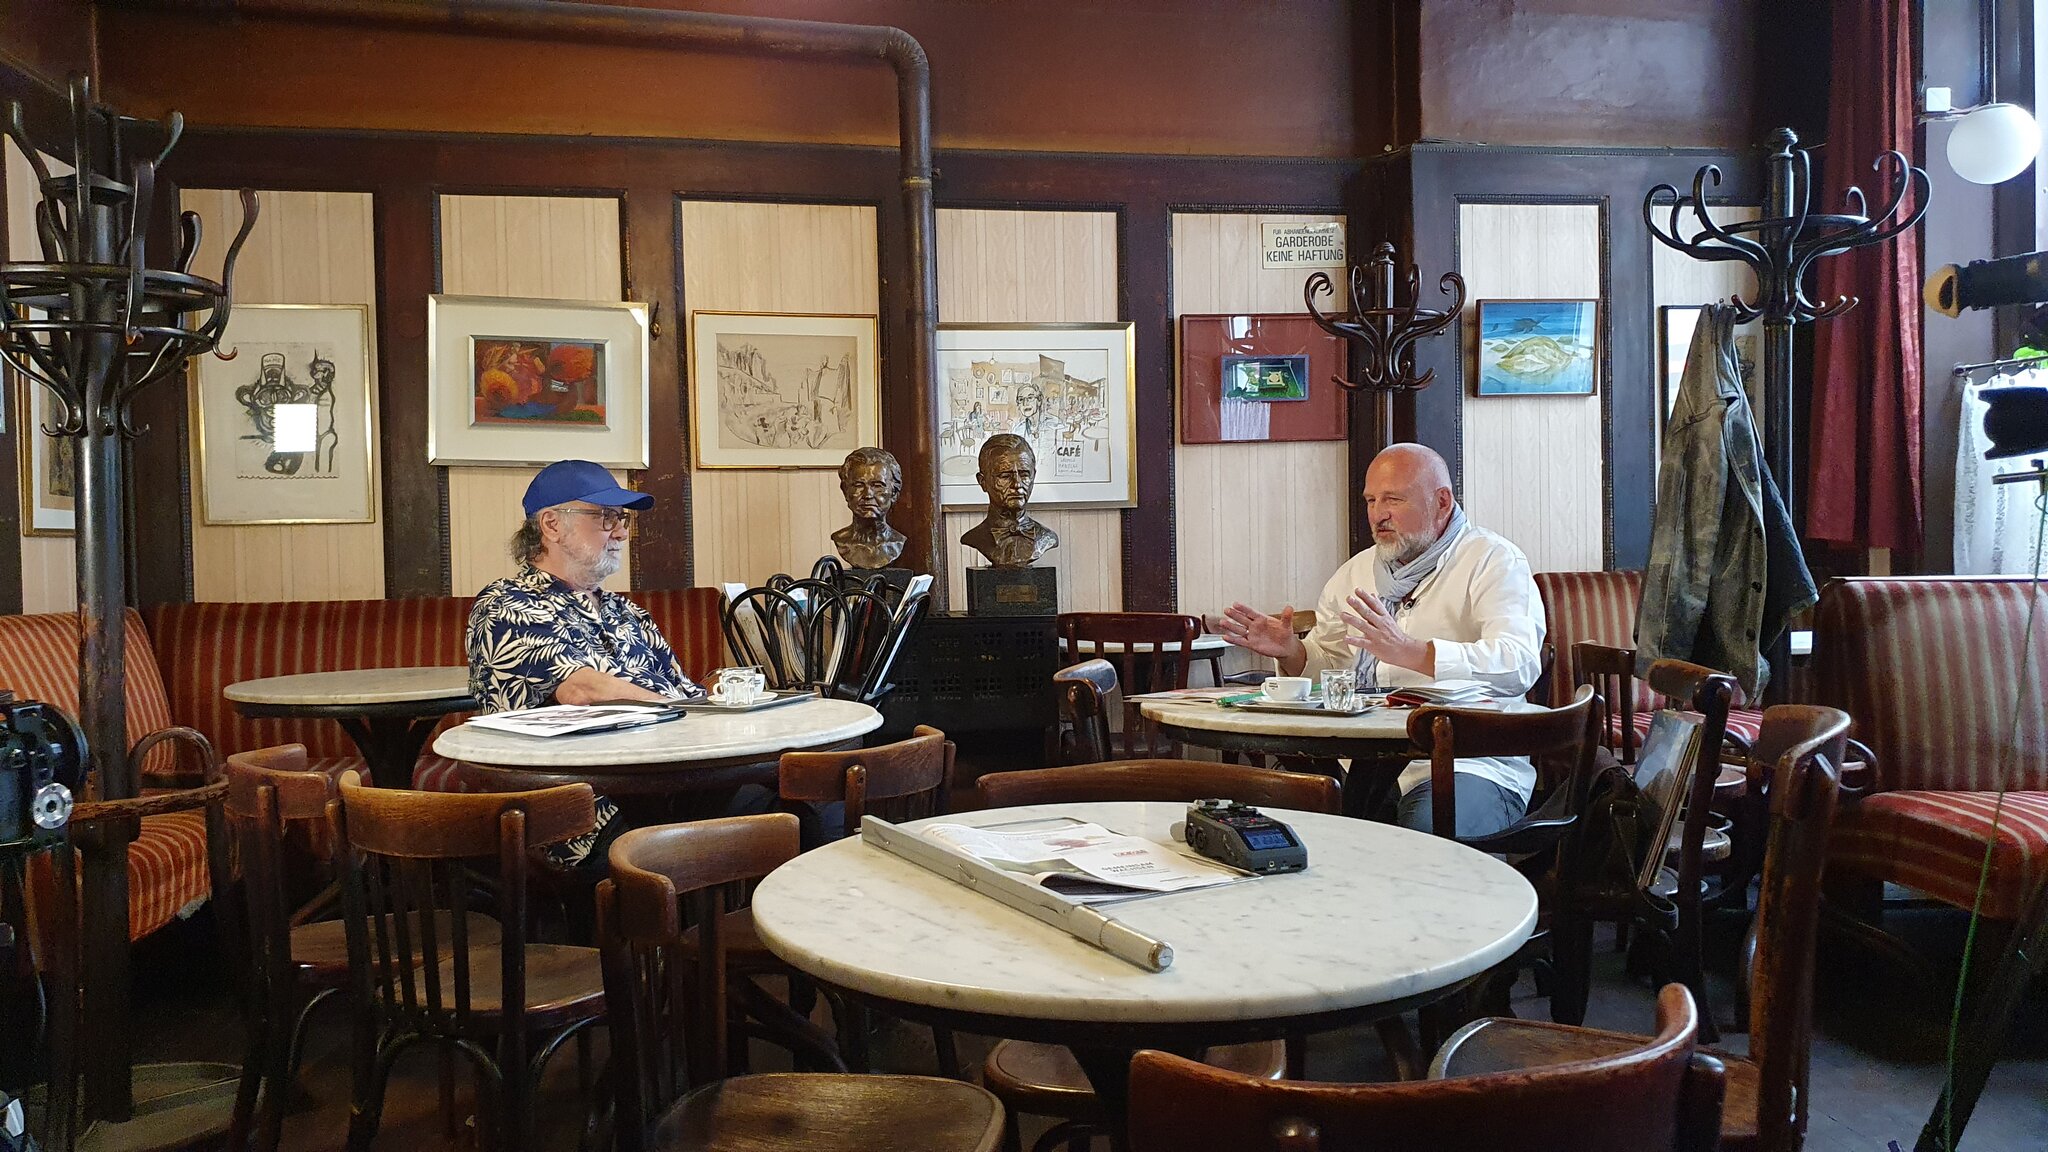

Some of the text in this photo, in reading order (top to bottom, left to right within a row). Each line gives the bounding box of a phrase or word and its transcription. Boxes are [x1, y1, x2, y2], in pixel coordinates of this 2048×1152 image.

[1275, 235, 1334, 248] GARDEROBE
[1266, 249, 1344, 262] KEINE HAFTUNG
[1057, 444, 1081, 457] CAFÉ
